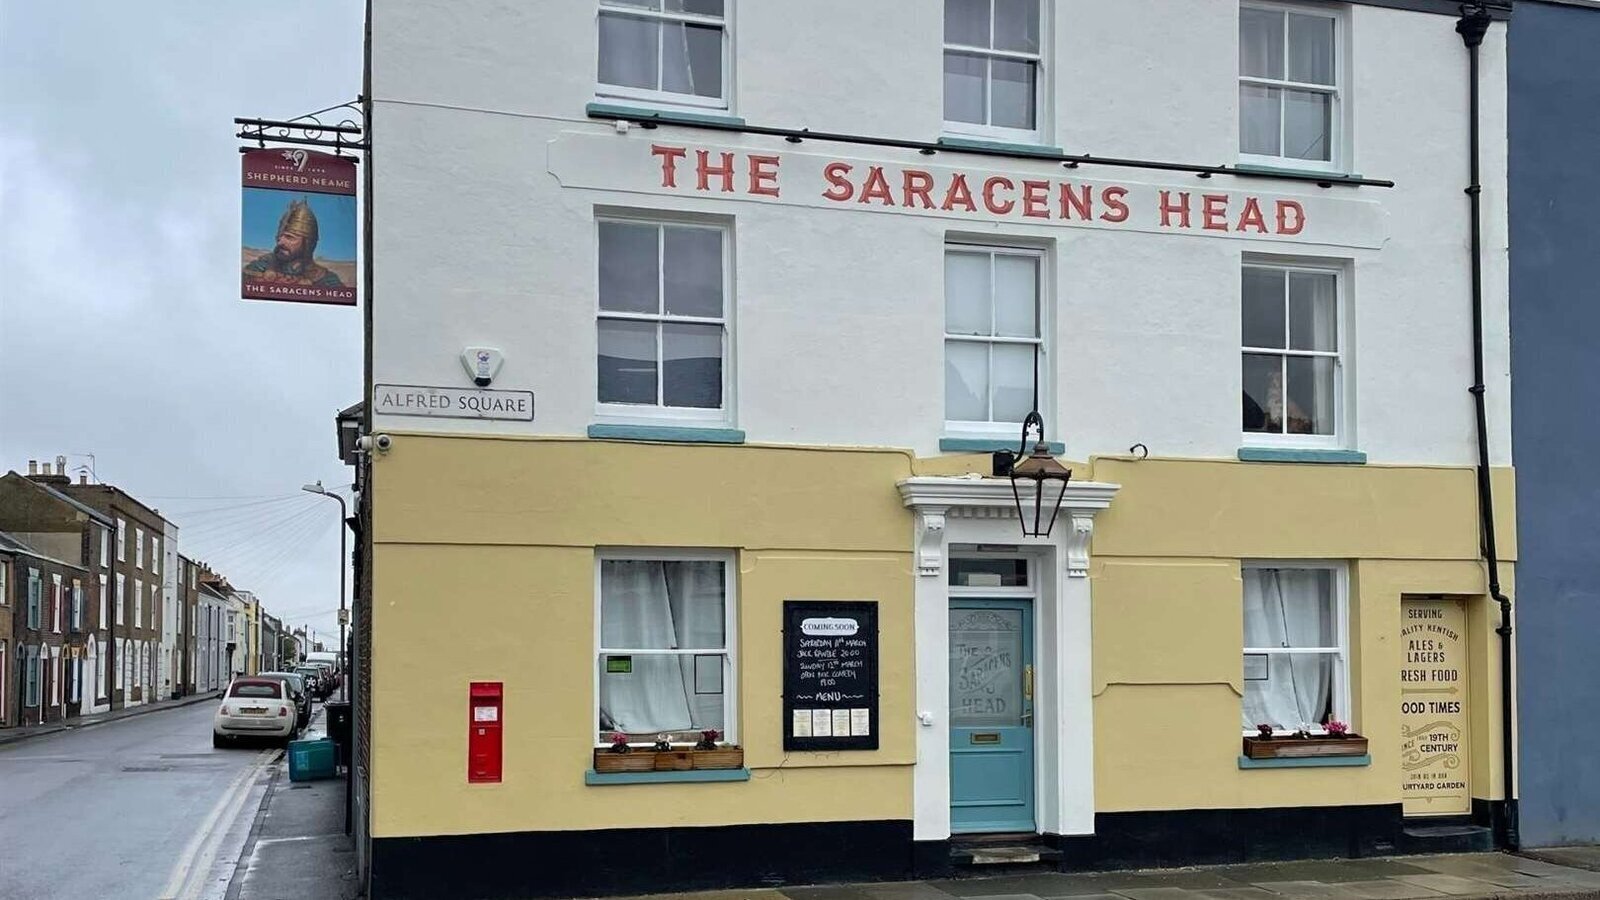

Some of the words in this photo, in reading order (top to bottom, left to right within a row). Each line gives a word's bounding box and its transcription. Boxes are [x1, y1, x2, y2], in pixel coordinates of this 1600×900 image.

[247, 171, 308, 184] SHEPHERD
[312, 177, 351, 188] NEAME
[651, 144, 780, 198] THE
[821, 161, 1130, 223] SARACENS
[1159, 189, 1306, 236] HEAD
[245, 284, 265, 292] THE
[269, 286, 322, 297] SARACENS
[325, 290, 353, 298] HEAD
[382, 393, 450, 409] ALFRED
[458, 396, 526, 413] SQUARE
[1408, 609, 1443, 619] SERVING
[1401, 623, 1424, 637] ALITY
[1427, 623, 1459, 641] KENTISH
[955, 644, 979, 656] THE
[1409, 640, 1434, 651] ALES
[1407, 652, 1445, 663] LAGERS
[1401, 669, 1427, 682] RESH
[1431, 669, 1458, 682] FOOD
[815, 692, 841, 701] MENU
[962, 697, 1006, 714] HEAD
[1401, 702, 1426, 714] OOD
[1429, 701, 1461, 714] TIMES
[1429, 733, 1449, 742] 19TH
[1420, 744, 1458, 752] CENTURY
